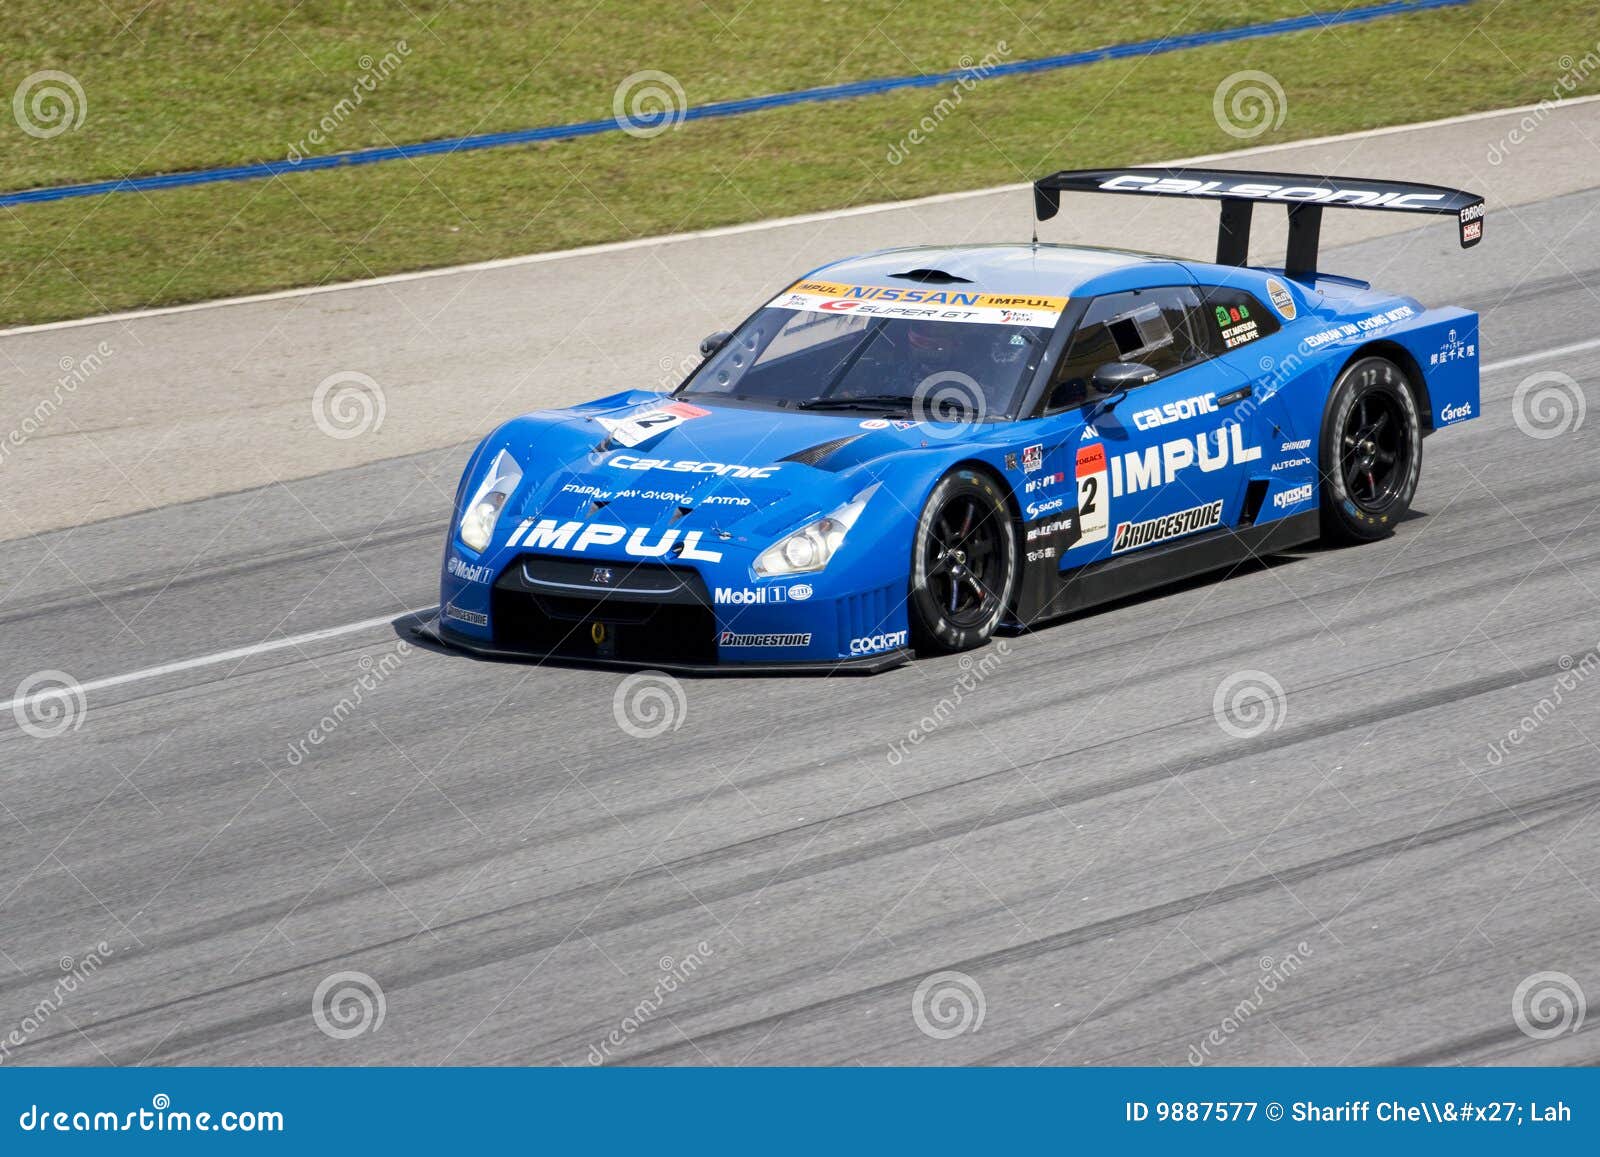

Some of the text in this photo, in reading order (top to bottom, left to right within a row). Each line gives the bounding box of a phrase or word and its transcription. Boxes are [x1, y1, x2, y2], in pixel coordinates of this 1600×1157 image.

[1461, 203, 1485, 223] EBBRO
[844, 287, 980, 306] NISSAN
[988, 297, 1057, 308] IMPUL
[856, 305, 981, 319] SUPER GT
[1339, 323, 1361, 338] TAN
[1357, 314, 1390, 331] CHONG
[1385, 305, 1415, 322] MOTOR
[636, 414, 677, 429] 2
[1441, 401, 1472, 421] Carest
[1111, 423, 1262, 497] IMPUL
[1039, 499, 1063, 513] SACHS
[1080, 477, 1098, 517] 2
[1112, 499, 1224, 554] BRIDGESTONE
[505, 519, 723, 563] IMPUL
[455, 561, 482, 583] Mobil
[714, 587, 766, 604] Mobil
[719, 632, 812, 647] BRIDGESTONE
[850, 630, 907, 653] COCKPIT
